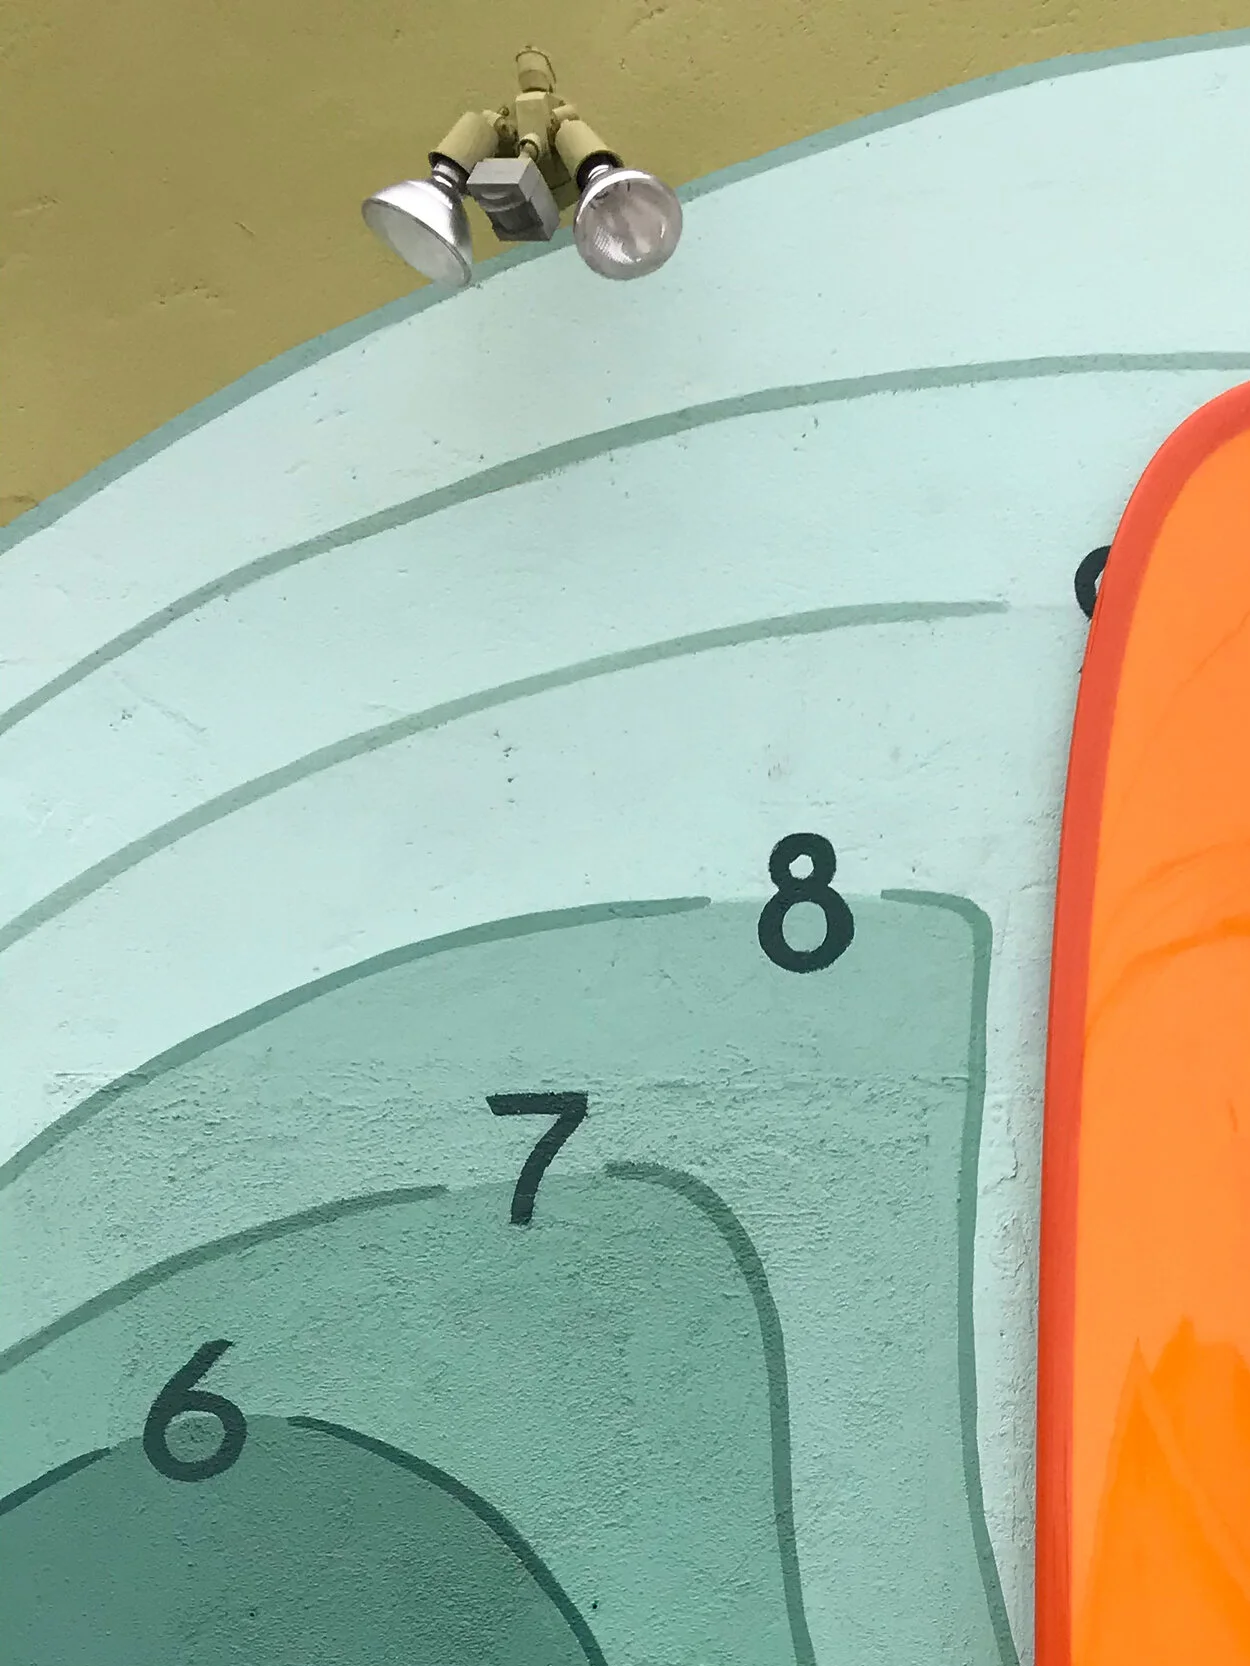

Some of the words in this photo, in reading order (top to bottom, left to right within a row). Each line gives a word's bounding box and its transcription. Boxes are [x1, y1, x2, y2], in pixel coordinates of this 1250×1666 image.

[757, 832, 855, 974] 8
[485, 1091, 589, 1226] 7
[142, 1338, 248, 1483] 6
